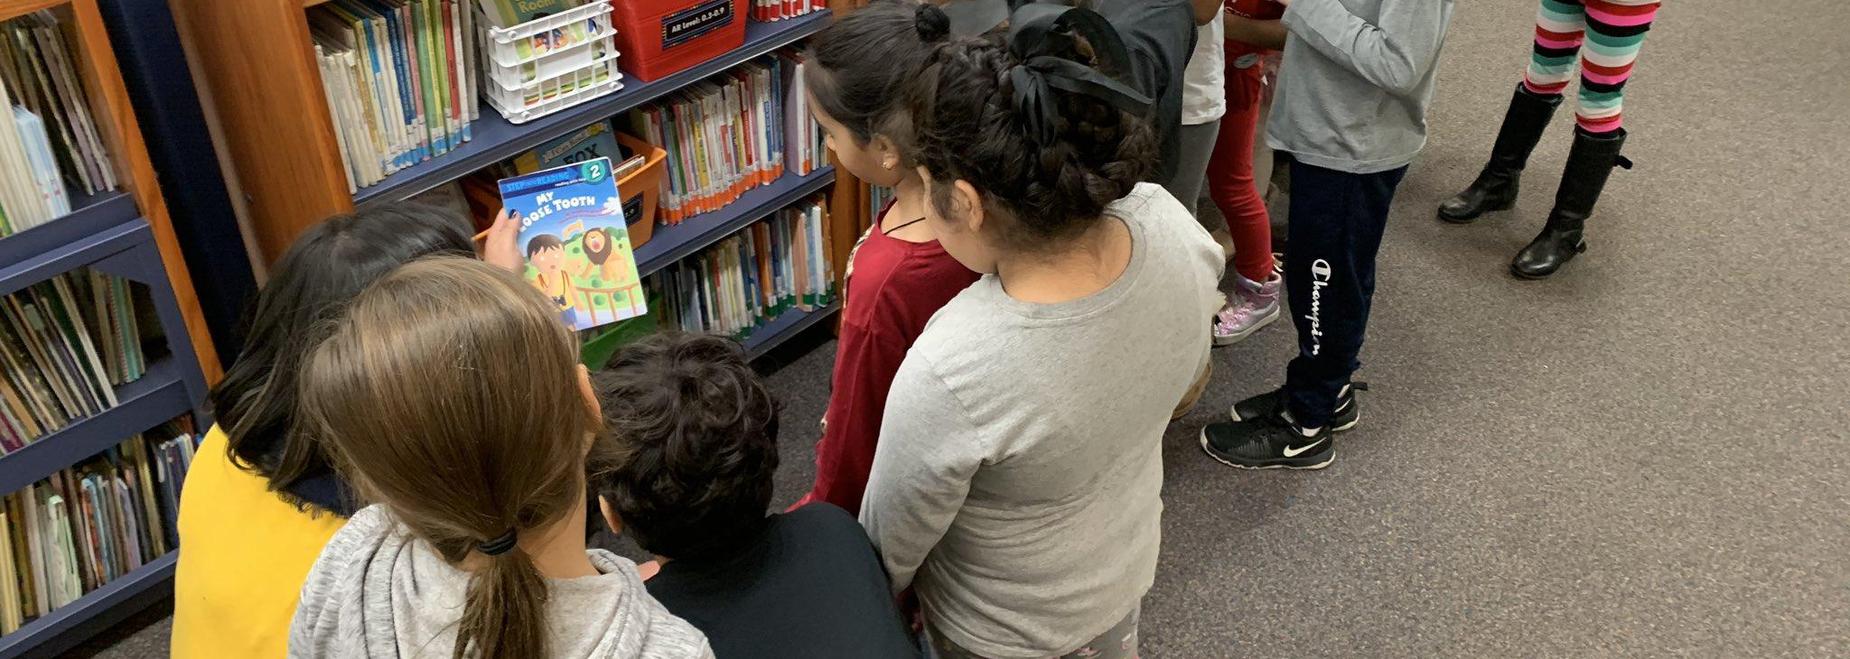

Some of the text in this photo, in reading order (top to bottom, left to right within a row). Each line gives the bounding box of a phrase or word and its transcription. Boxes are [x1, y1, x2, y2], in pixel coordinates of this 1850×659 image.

[671, 24, 681, 33] AR
[682, 17, 701, 29] Level:
[590, 164, 601, 179] 2
[536, 191, 554, 206] MY
[552, 196, 596, 211] TOOTH
[1304, 258, 1332, 356] Champin
